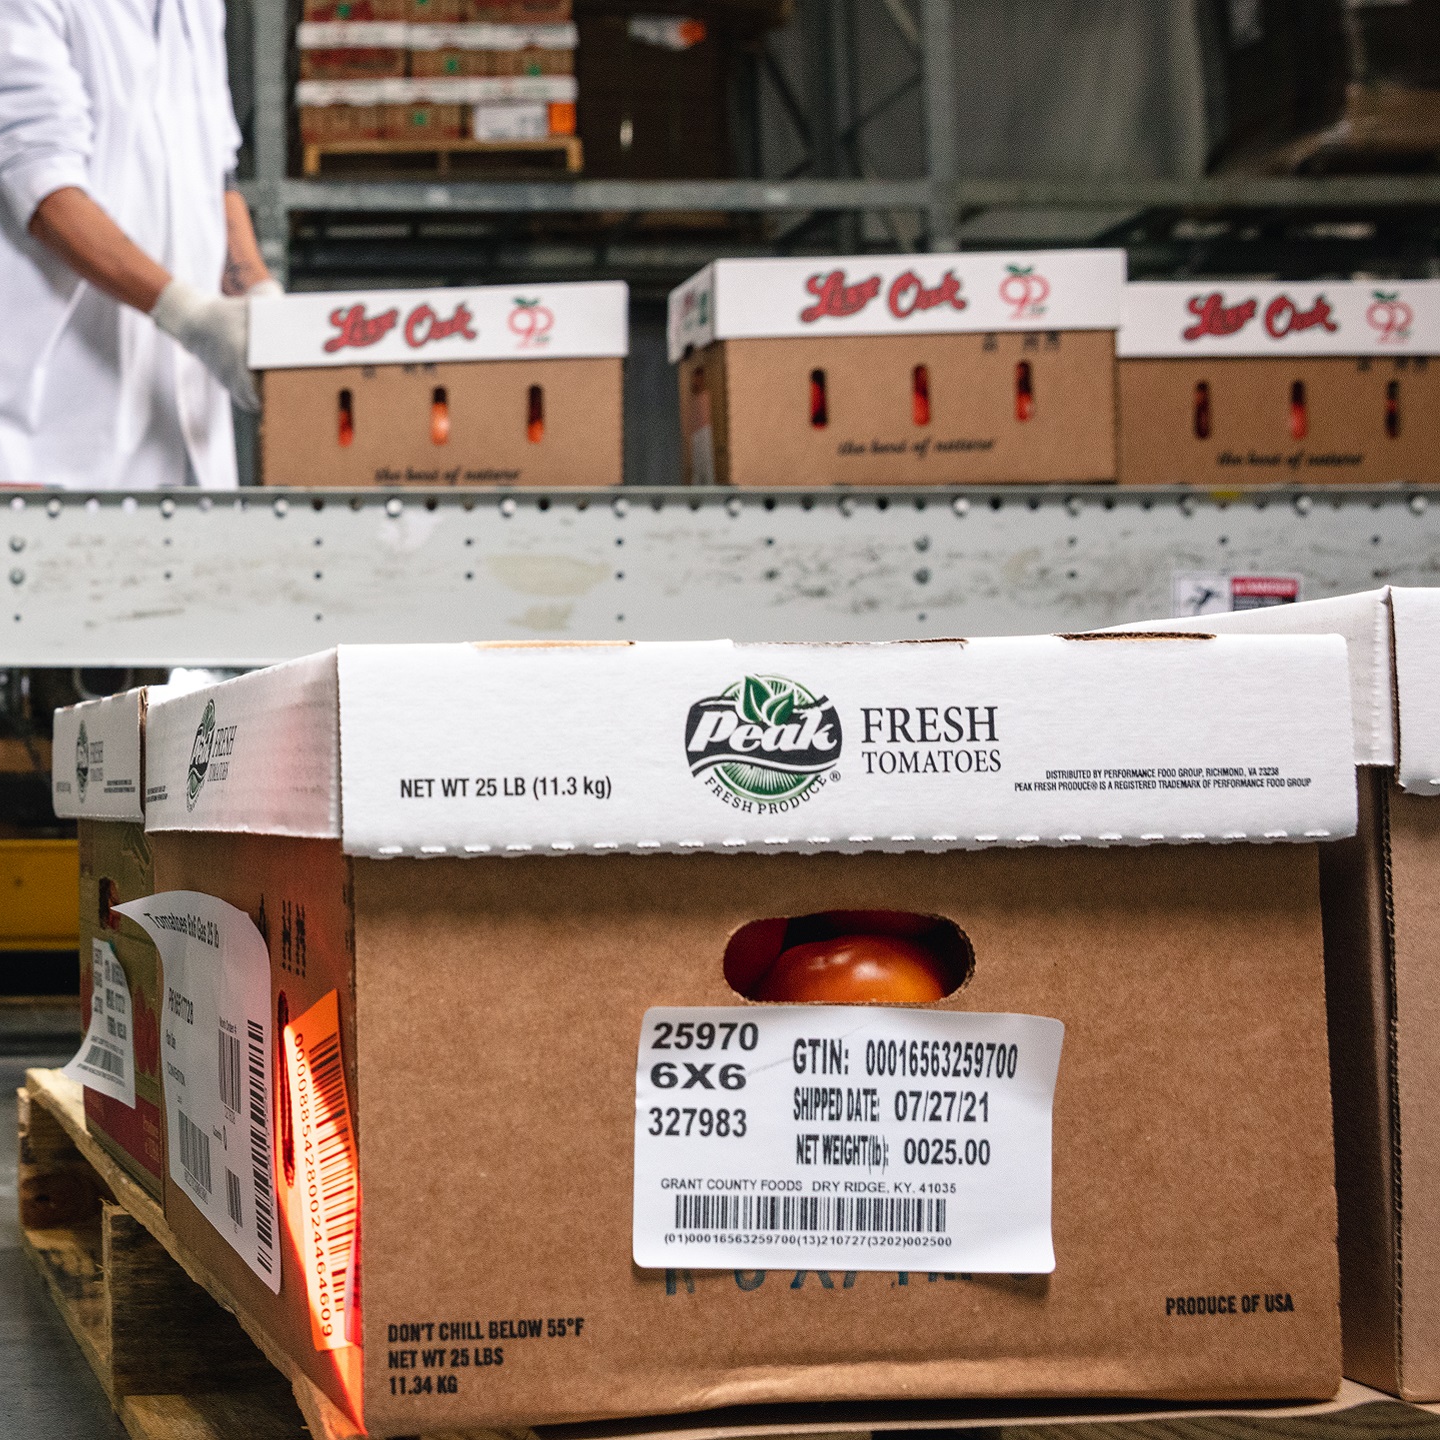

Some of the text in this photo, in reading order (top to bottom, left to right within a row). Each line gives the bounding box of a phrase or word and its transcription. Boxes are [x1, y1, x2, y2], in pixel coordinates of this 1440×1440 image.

[687, 707, 838, 752] Peak
[861, 706, 1000, 743] FRESH
[212, 725, 238, 758] FRESH
[862, 749, 1002, 774] TOMATOES
[1046, 769, 1092, 780] DISTRIBUTED
[1093, 769, 1102, 779] BY
[1104, 768, 1156, 779] PERFORMANCE
[1157, 768, 1176, 778] FOOD
[1178, 767, 1204, 779] GROUP,
[1248, 767, 1258, 777] VA
[401, 775, 612, 800] NET WT 25 LB (11.3 kg)
[705, 777, 752, 813] FRESH
[1014, 782, 1032, 792] PEAK
[1034, 781, 1057, 791] FRESH
[1114, 779, 1157, 790] REGISTERED
[1158, 779, 1201, 790] TRADEMARK
[1202, 779, 1211, 789] OF
[1213, 778, 1265, 789] PERFORMANCE
[1266, 778, 1285, 788] FOOD
[1287, 777, 1312, 788] GROUP
[651, 1022, 759, 1051] 25970
[793, 1038, 1019, 1079] GTIN: 00016563259700
[650, 1062, 747, 1090] 6X6
[793, 1087, 990, 1123] SHIPPED DATE: 07/27/21
[648, 1107, 748, 1138] 327983
[796, 1134, 991, 1174] NET WEIGHT(lb): 0025.00
[293, 1032, 334, 1338] 00008854280024464609
[661, 1178, 703, 1191] GRANT
[707, 1178, 757, 1191] COUNTY
[761, 1180, 803, 1192] FOODS
[812, 1181, 840, 1193] DRY
[844, 1181, 890, 1194] RIDGE,
[919, 1182, 957, 1194] 41035
[664, 1233, 952, 1247] (01)00016563259700(13)210727(3202)002500
[1166, 1293, 1295, 1316] PRODUCE OF USA
[388, 1317, 585, 1342] DON'T CHILL BELOW 55°F
[388, 1347, 504, 1369] NET WT 25 LBS
[389, 1375, 458, 1395] 11.34 KG
